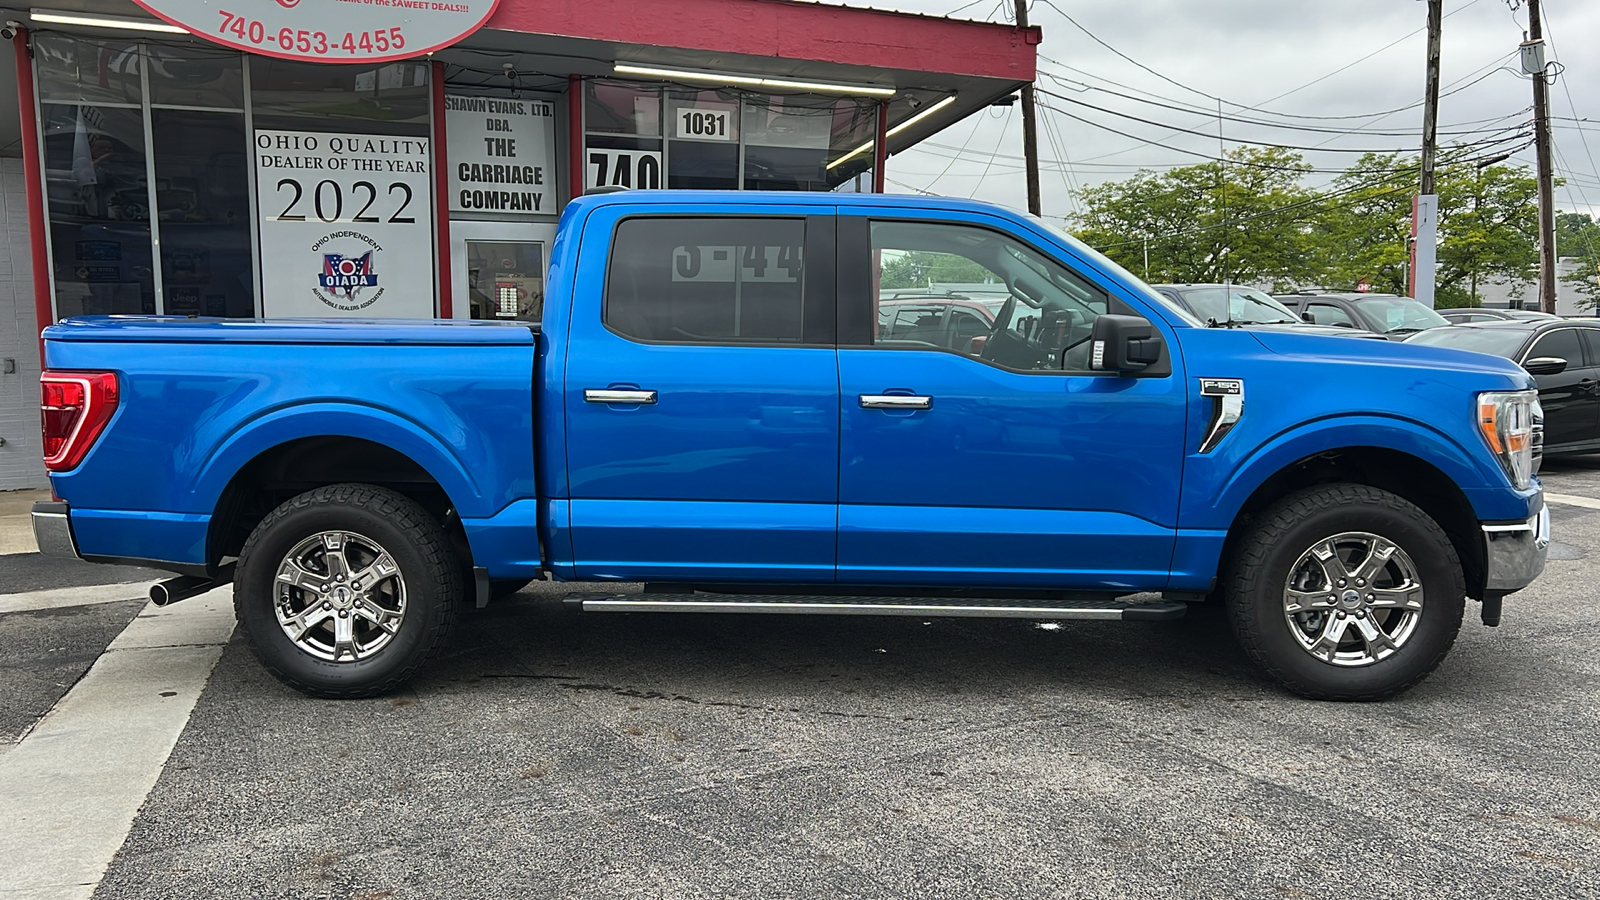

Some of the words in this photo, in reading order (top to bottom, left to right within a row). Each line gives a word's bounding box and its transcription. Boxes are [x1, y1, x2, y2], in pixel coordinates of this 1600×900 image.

[391, 0, 430, 10] SAWEET
[431, 3, 469, 13] DEALS!!!
[218, 10, 405, 54] 740-653-4455
[445, 97, 486, 112] SHAWN
[531, 103, 553, 117] LTD.
[486, 118, 513, 132] DBA.
[682, 112, 725, 136] 1031
[257, 134, 318, 151] OHIO
[329, 137, 427, 155] QUALITY
[484, 137, 516, 157] THE
[261, 155, 324, 170] DEALER
[327, 157, 348, 170] OF
[352, 158, 383, 172] THE
[386, 160, 426, 173] YEAR
[458, 162, 543, 185] CARRIAGE
[589, 153, 659, 190] 740
[276, 178, 416, 224] 2022
[460, 189, 543, 211] COMPANY
[311, 235, 330, 252] OHIO
[329, 230, 384, 252] INDEPENDENT
[326, 275, 368, 286] OIADA
[172, 293, 198, 304] Jeep
[312, 287, 338, 310] AUTOMOBILE
[360, 286, 385, 309] ASSOCIATION
